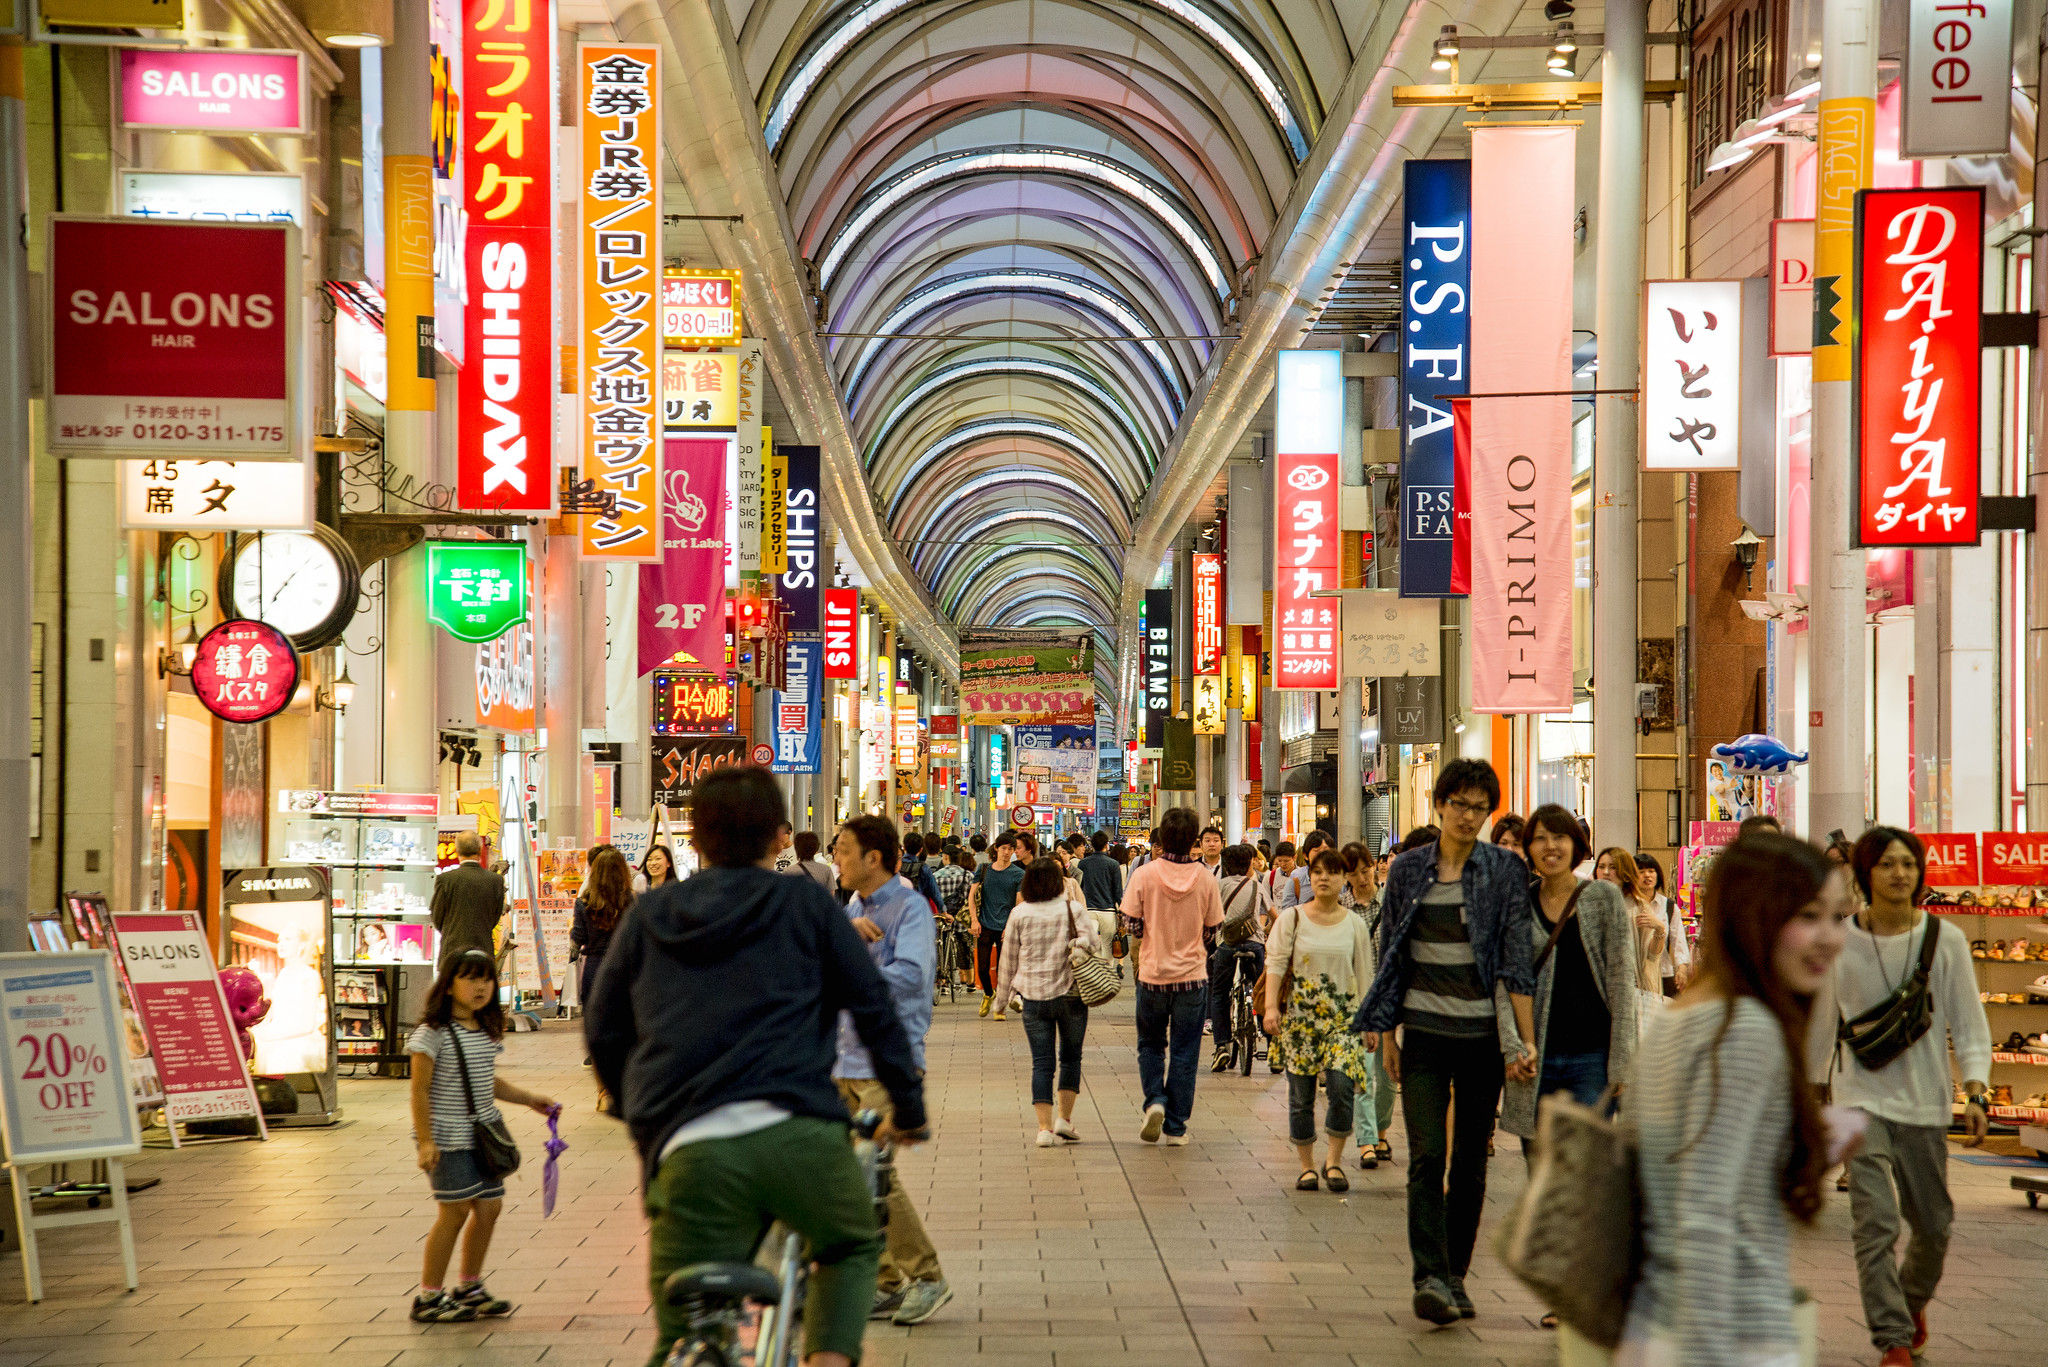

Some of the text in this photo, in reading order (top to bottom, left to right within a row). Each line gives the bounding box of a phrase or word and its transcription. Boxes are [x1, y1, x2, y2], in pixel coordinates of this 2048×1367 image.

[141, 69, 286, 100] SALONS
[199, 102, 231, 114] HAIR
[474, 0, 533, 220] カラオケ
[1781, 259, 1813, 284] D
[69, 289, 274, 329] SALONS
[667, 312, 731, 334] 980円!!
[1408, 220, 1466, 446] P.S.FA
[151, 334, 196, 348] HAIR
[481, 242, 527, 495] SHIDAX
[663, 359, 723, 392] 麻雀
[1667, 307, 1718, 457] いとや
[134, 405, 213, 421] 予約受付中
[666, 399, 712, 421] リオ
[132, 424, 284, 442] 0120-311-175
[146, 487, 175, 514] 席
[771, 468, 782, 566] ダーツアクセサリー
[1873, 502, 1966, 533] ダイヤ
[664, 536, 723, 549] art Labo
[782, 488, 815, 590] SHIPS
[1293, 500, 1324, 599] タナカ
[1507, 455, 1537, 684] I-PRIMO
[439, 579, 513, 602] 下村
[654, 603, 707, 630] 2F
[1283, 609, 1332, 625] メガネ
[214, 643, 273, 679] 鎌倉
[1149, 628, 1168, 710] BEAMS
[1282, 659, 1332, 675] コンタクト
[216, 679, 269, 702] パスタ
[778, 645, 810, 764] 古着買取
[756, 750, 770, 761] 20
[772, 764, 789, 772] BLUE
[653, 790, 675, 804] 5F
[1993, 843, 2048, 866] SALE
[241, 877, 312, 892] SHIMOMURA
[127, 943, 201, 962] SALONS
[16, 1032, 107, 1080] 20%
[39, 1081, 96, 1111] OFF
[171, 1100, 250, 1117] 0120-311-175
